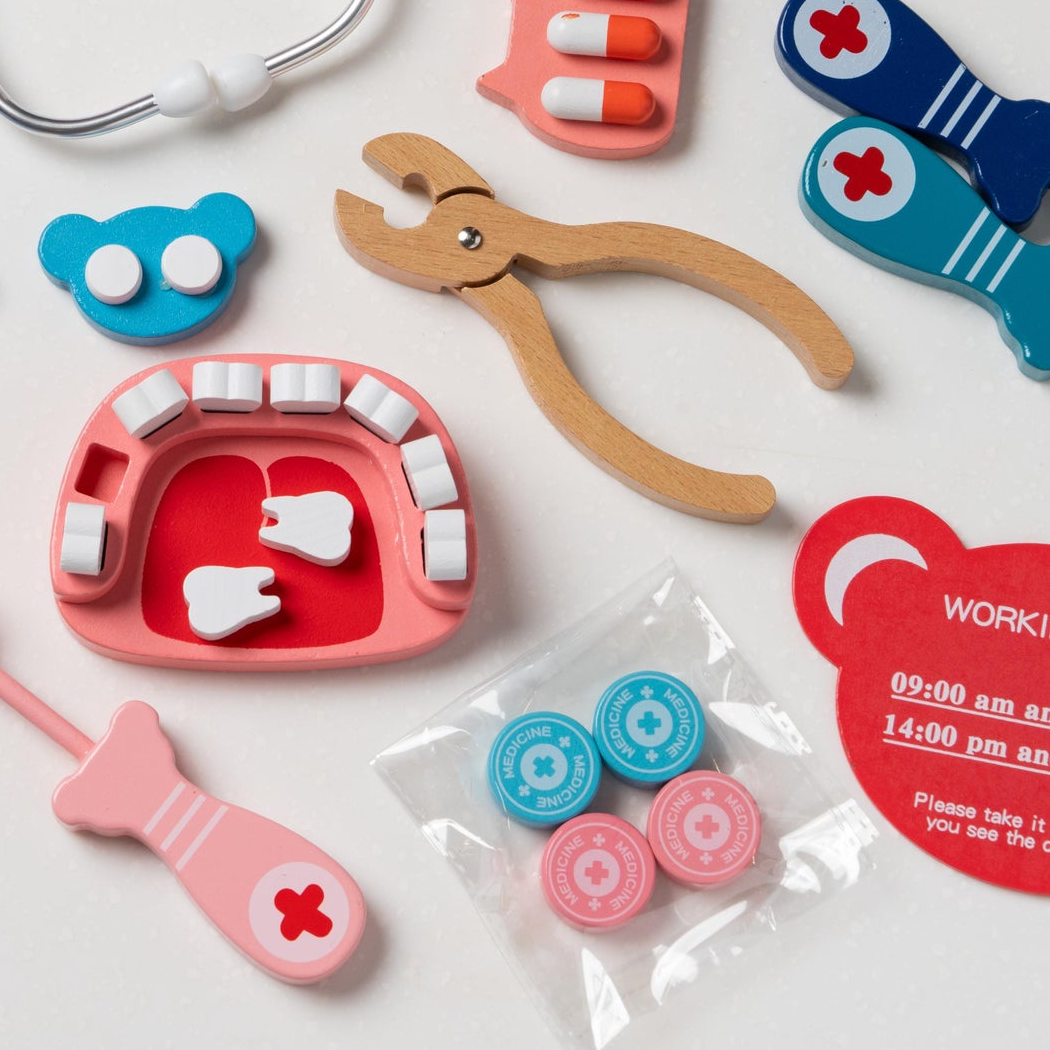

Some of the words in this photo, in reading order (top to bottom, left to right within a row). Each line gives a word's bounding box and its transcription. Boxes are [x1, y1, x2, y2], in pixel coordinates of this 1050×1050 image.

[944, 594, 1050, 639] WORKI
[891, 671, 966, 705] 09:00
[974, 693, 1014, 716] am
[608, 688, 634, 759] MEDICINE
[663, 688, 691, 758] MEDICINE
[883, 714, 957, 747] 14:00
[966, 735, 1007, 758] pm
[504, 725, 552, 779] MEDICINE
[536, 754, 586, 809] MEDICINE
[665, 789, 694, 861] MEDICINE
[720, 794, 749, 864] MEDICINE
[914, 791, 977, 819] Please
[984, 808, 1023, 829] take
[1031, 815, 1046, 833] it
[926, 816, 960, 834] you
[966, 824, 998, 842] see
[1006, 830, 1035, 849] the
[556, 834, 585, 906] MEDICINE
[611, 840, 638, 912] MEDICINE
